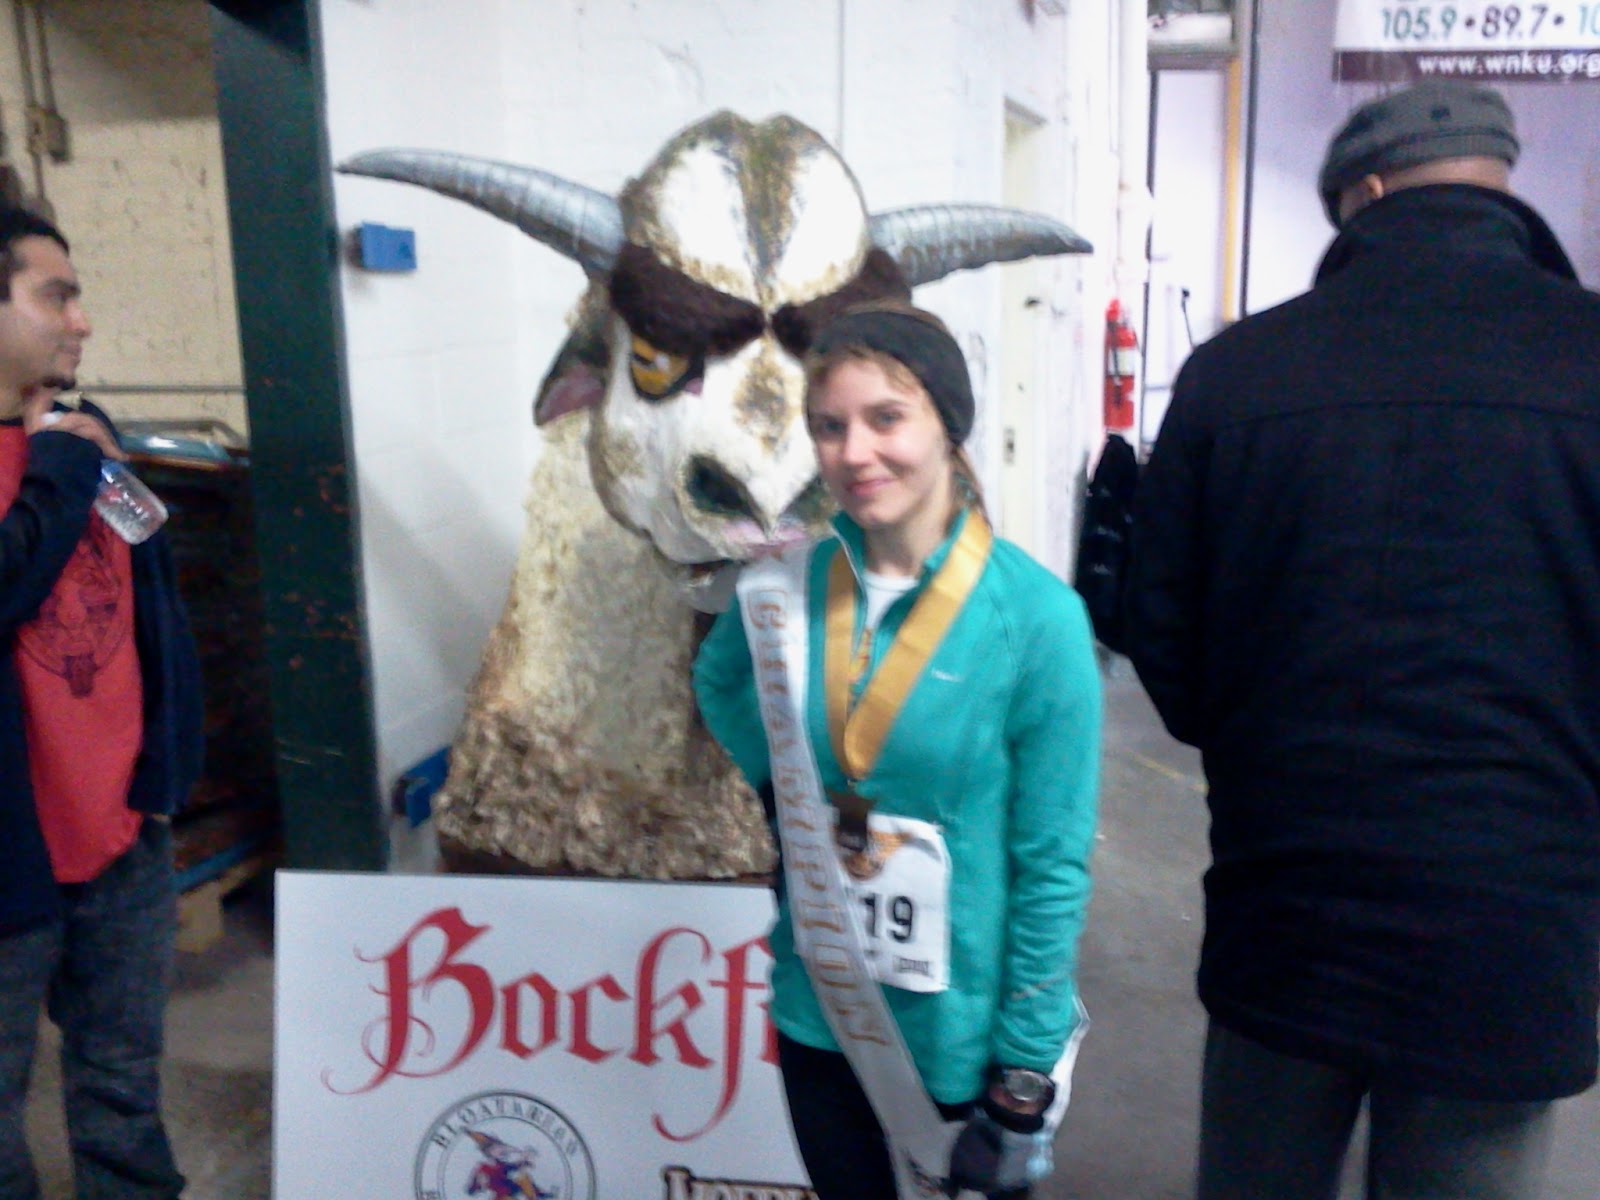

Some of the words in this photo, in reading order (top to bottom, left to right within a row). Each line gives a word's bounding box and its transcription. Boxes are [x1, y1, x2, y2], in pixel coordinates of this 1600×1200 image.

[1381, 6, 1457, 40] 105.9
[1481, 4, 1548, 39] 89.7
[1417, 53, 1600, 78] www.wnku.org
[321, 906, 780, 1142] Bockf
